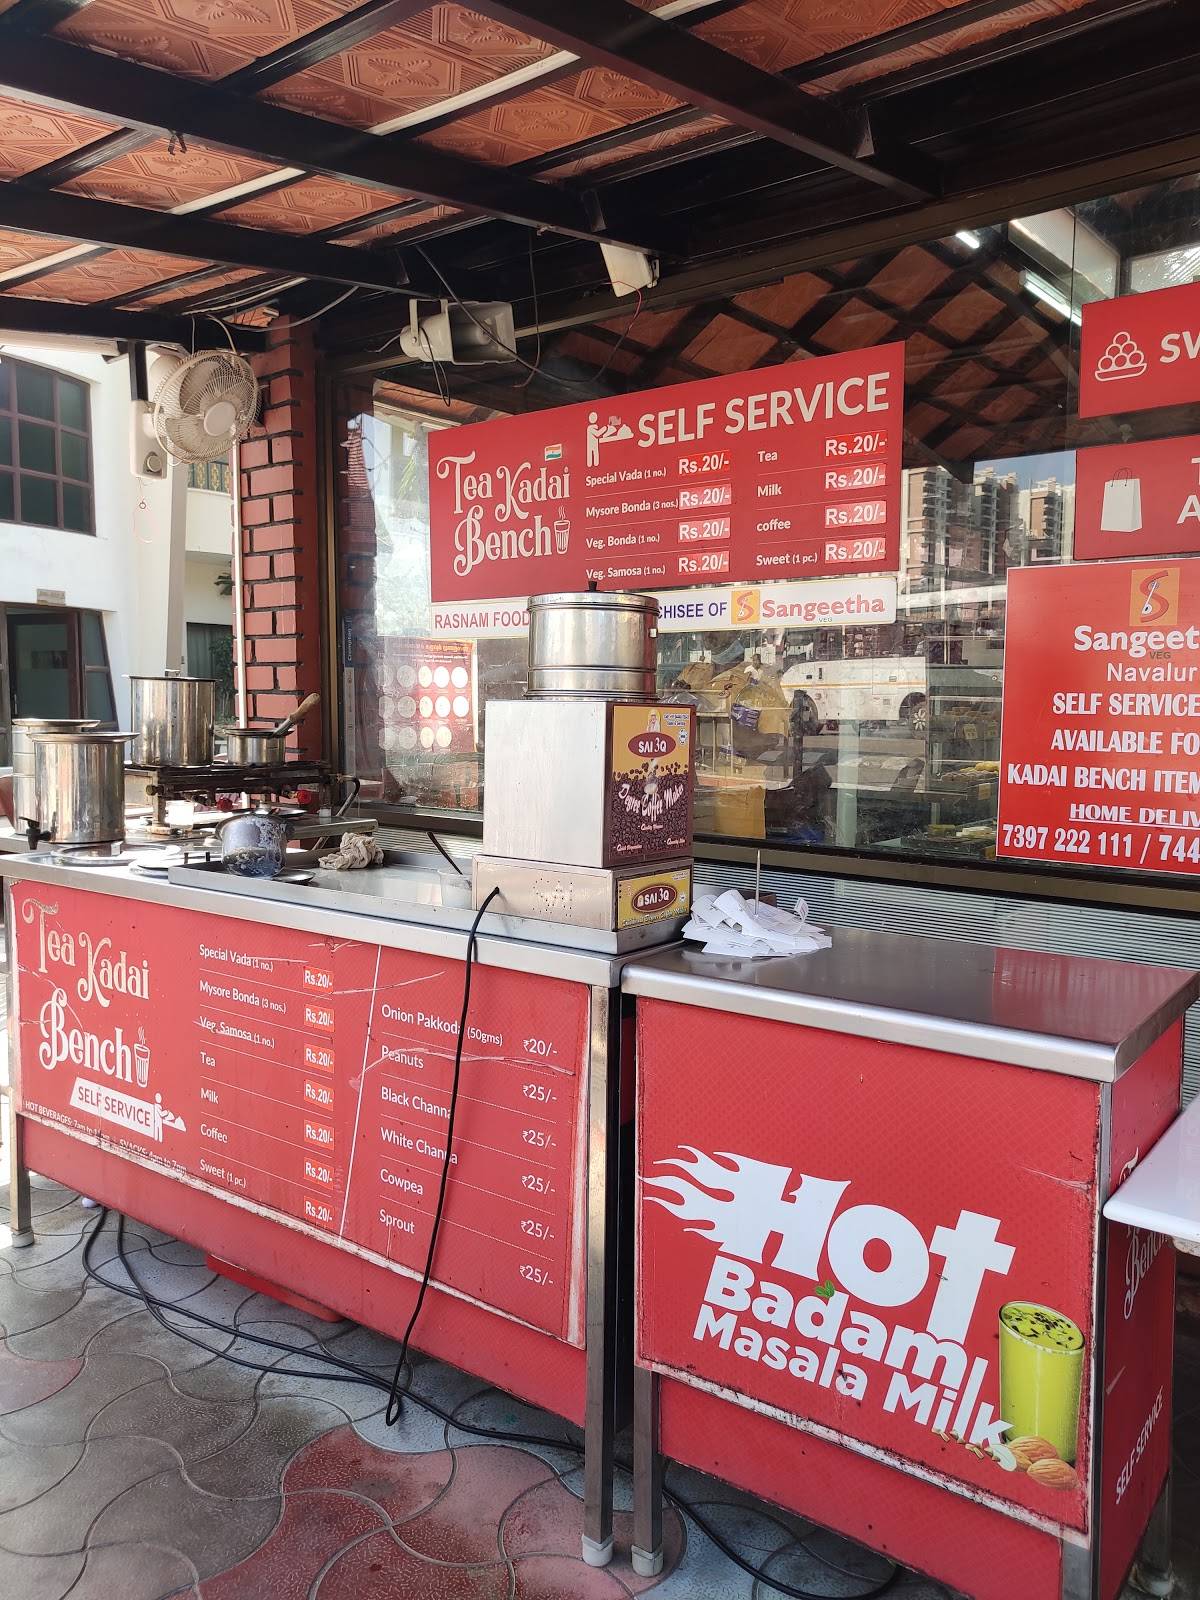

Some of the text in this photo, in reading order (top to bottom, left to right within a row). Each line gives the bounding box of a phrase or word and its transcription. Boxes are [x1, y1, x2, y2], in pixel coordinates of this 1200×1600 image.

[637, 371, 890, 448] SELF SERVICE
[758, 433, 885, 462] Tea Rs.20/-
[436, 450, 570, 522] Tea Kadai
[586, 453, 729, 487] Special Vada (1 no.) Rs.20/-
[758, 466, 885, 497] Milk Rs.20/-
[586, 487, 730, 518] Mysore Bonda (3 nos.) Rs.20/-
[757, 504, 885, 531] coffee Rs.20/-
[453, 505, 552, 576] Bench
[586, 520, 729, 549] Veg. Bonda (1 no.) Rs.20/-
[756, 540, 885, 566] Sweet (1 pc.) Rs.20/-
[586, 554, 728, 580] Veg. Samosa (1 no.) Rs.20/-
[435, 610, 530, 629] RASNAM FOOD
[709, 601, 728, 616] OF
[762, 595, 886, 621] Sangeetha
[1074, 625, 1200, 658] Sangeet
[1149, 651, 1171, 660] VEG
[1107, 662, 1198, 682] Navalur
[1052, 692, 1200, 717] SELF SERVICE
[1051, 729, 1200, 756] AVAILABLE FO
[1007, 763, 1067, 787] KADAI
[1074, 766, 1146, 791] BENCH
[641, 792, 663, 821] Coffee
[1070, 803, 1132, 821] HOME
[1002, 824, 1200, 864] 7397 222 111 / 744
[22, 898, 150, 1008] Tea Kadai
[199, 944, 333, 988] Special Vada (1 no.) Rs.20/-
[200, 980, 333, 1025] Mysore Bonda (3 nos.) Rs.20/-
[39, 987, 133, 1083] Bench
[200, 1016, 218, 1034] Veg.
[219, 1022, 252, 1042] Samosa
[261, 1035, 275, 1049] no.)
[305, 1048, 333, 1067] Rs.20/-
[381, 1004, 414, 1024] Onion
[467, 1026, 503, 1047] (50gms)
[523, 1038, 558, 1056] ₹20/-
[200, 1051, 333, 1104] Tea Rs.20/-
[381, 1045, 557, 1103] Peanuts ₹25/-
[25, 1100, 38, 1112] HOT
[78, 1086, 151, 1127] SELF SERVICE
[200, 1088, 333, 1144] Milk Rs.20/-
[381, 1086, 409, 1107] Black
[522, 1129, 556, 1149] ₹25/-
[305, 1162, 333, 1183] Rs.20/-
[381, 1127, 413, 1150] White
[521, 1175, 555, 1194] ₹25/-
[200, 1158, 332, 1222] Sweet (1 pc.) Rs.20/-
[380, 1168, 554, 1240] Cowpea ₹25/-
[379, 1209, 553, 1285] Sprout ₹25/-
[645, 1145, 1016, 1345] Hot
[704, 1255, 968, 1390] Badam
[693, 1304, 1015, 1449] Masala Milk
[1116, 1385, 1163, 1505] SELF SERVICE
